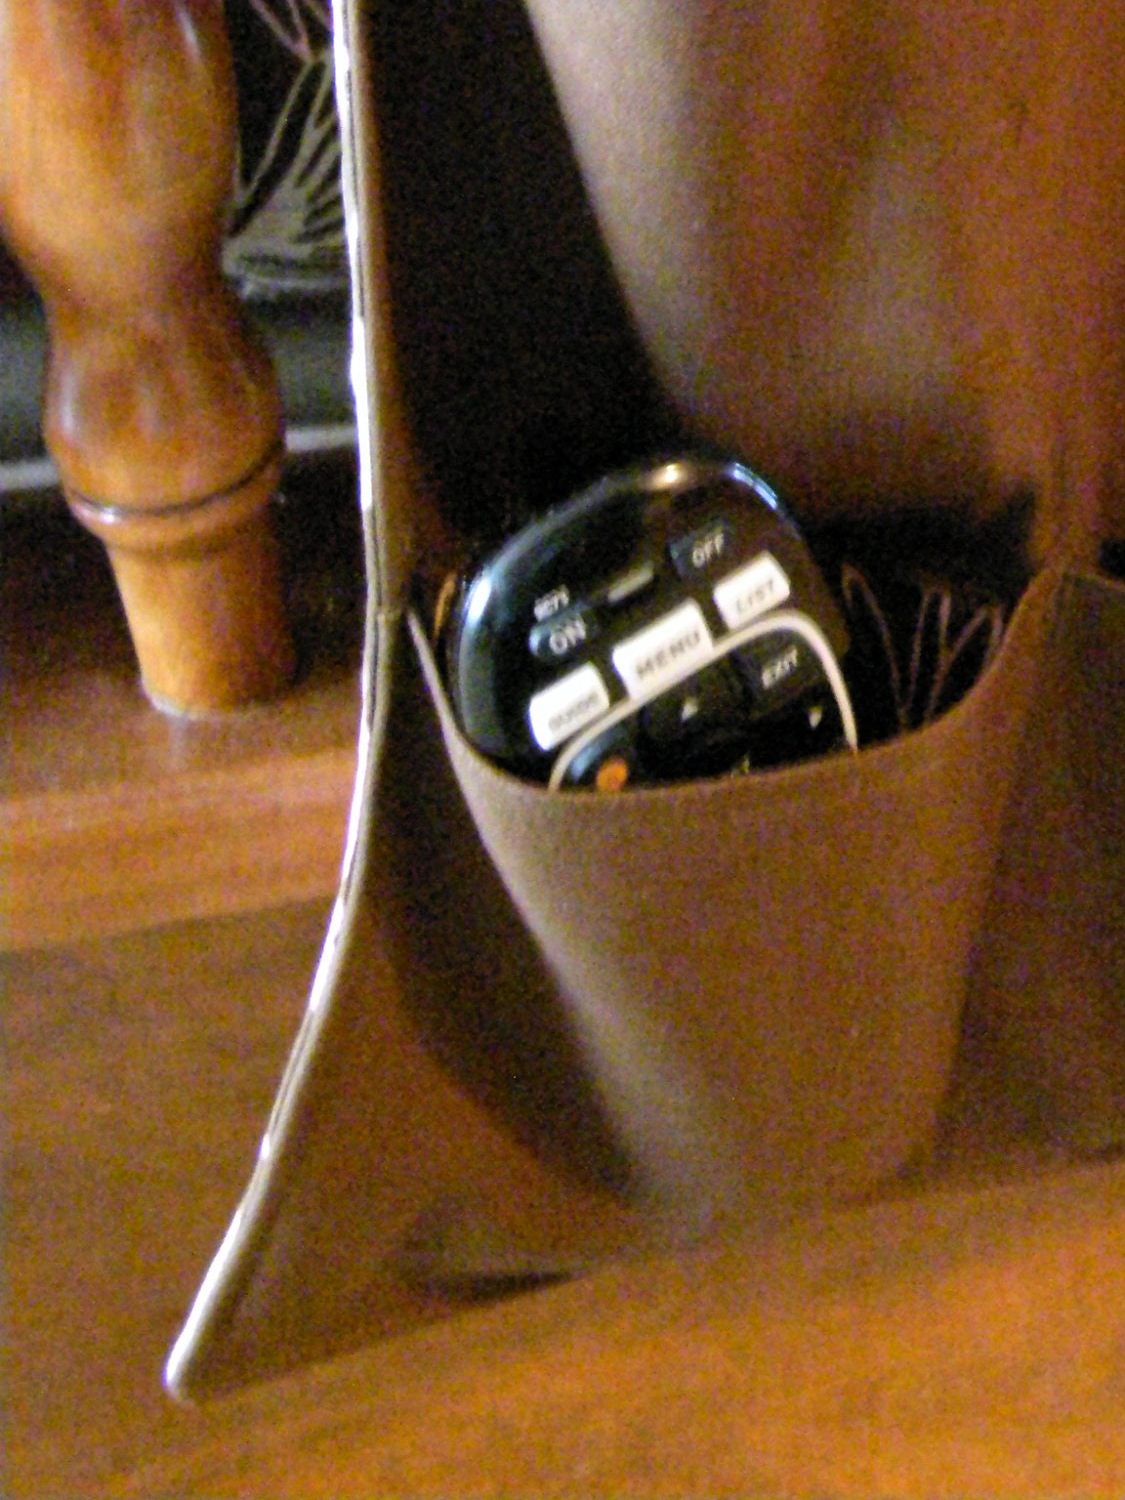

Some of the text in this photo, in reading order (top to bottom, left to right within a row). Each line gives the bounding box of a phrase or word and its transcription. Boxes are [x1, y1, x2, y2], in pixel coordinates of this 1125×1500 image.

[692, 528, 725, 569] OFF
[735, 577, 776, 613] LIST
[549, 614, 587, 655] ON
[634, 629, 702, 680] MENU
